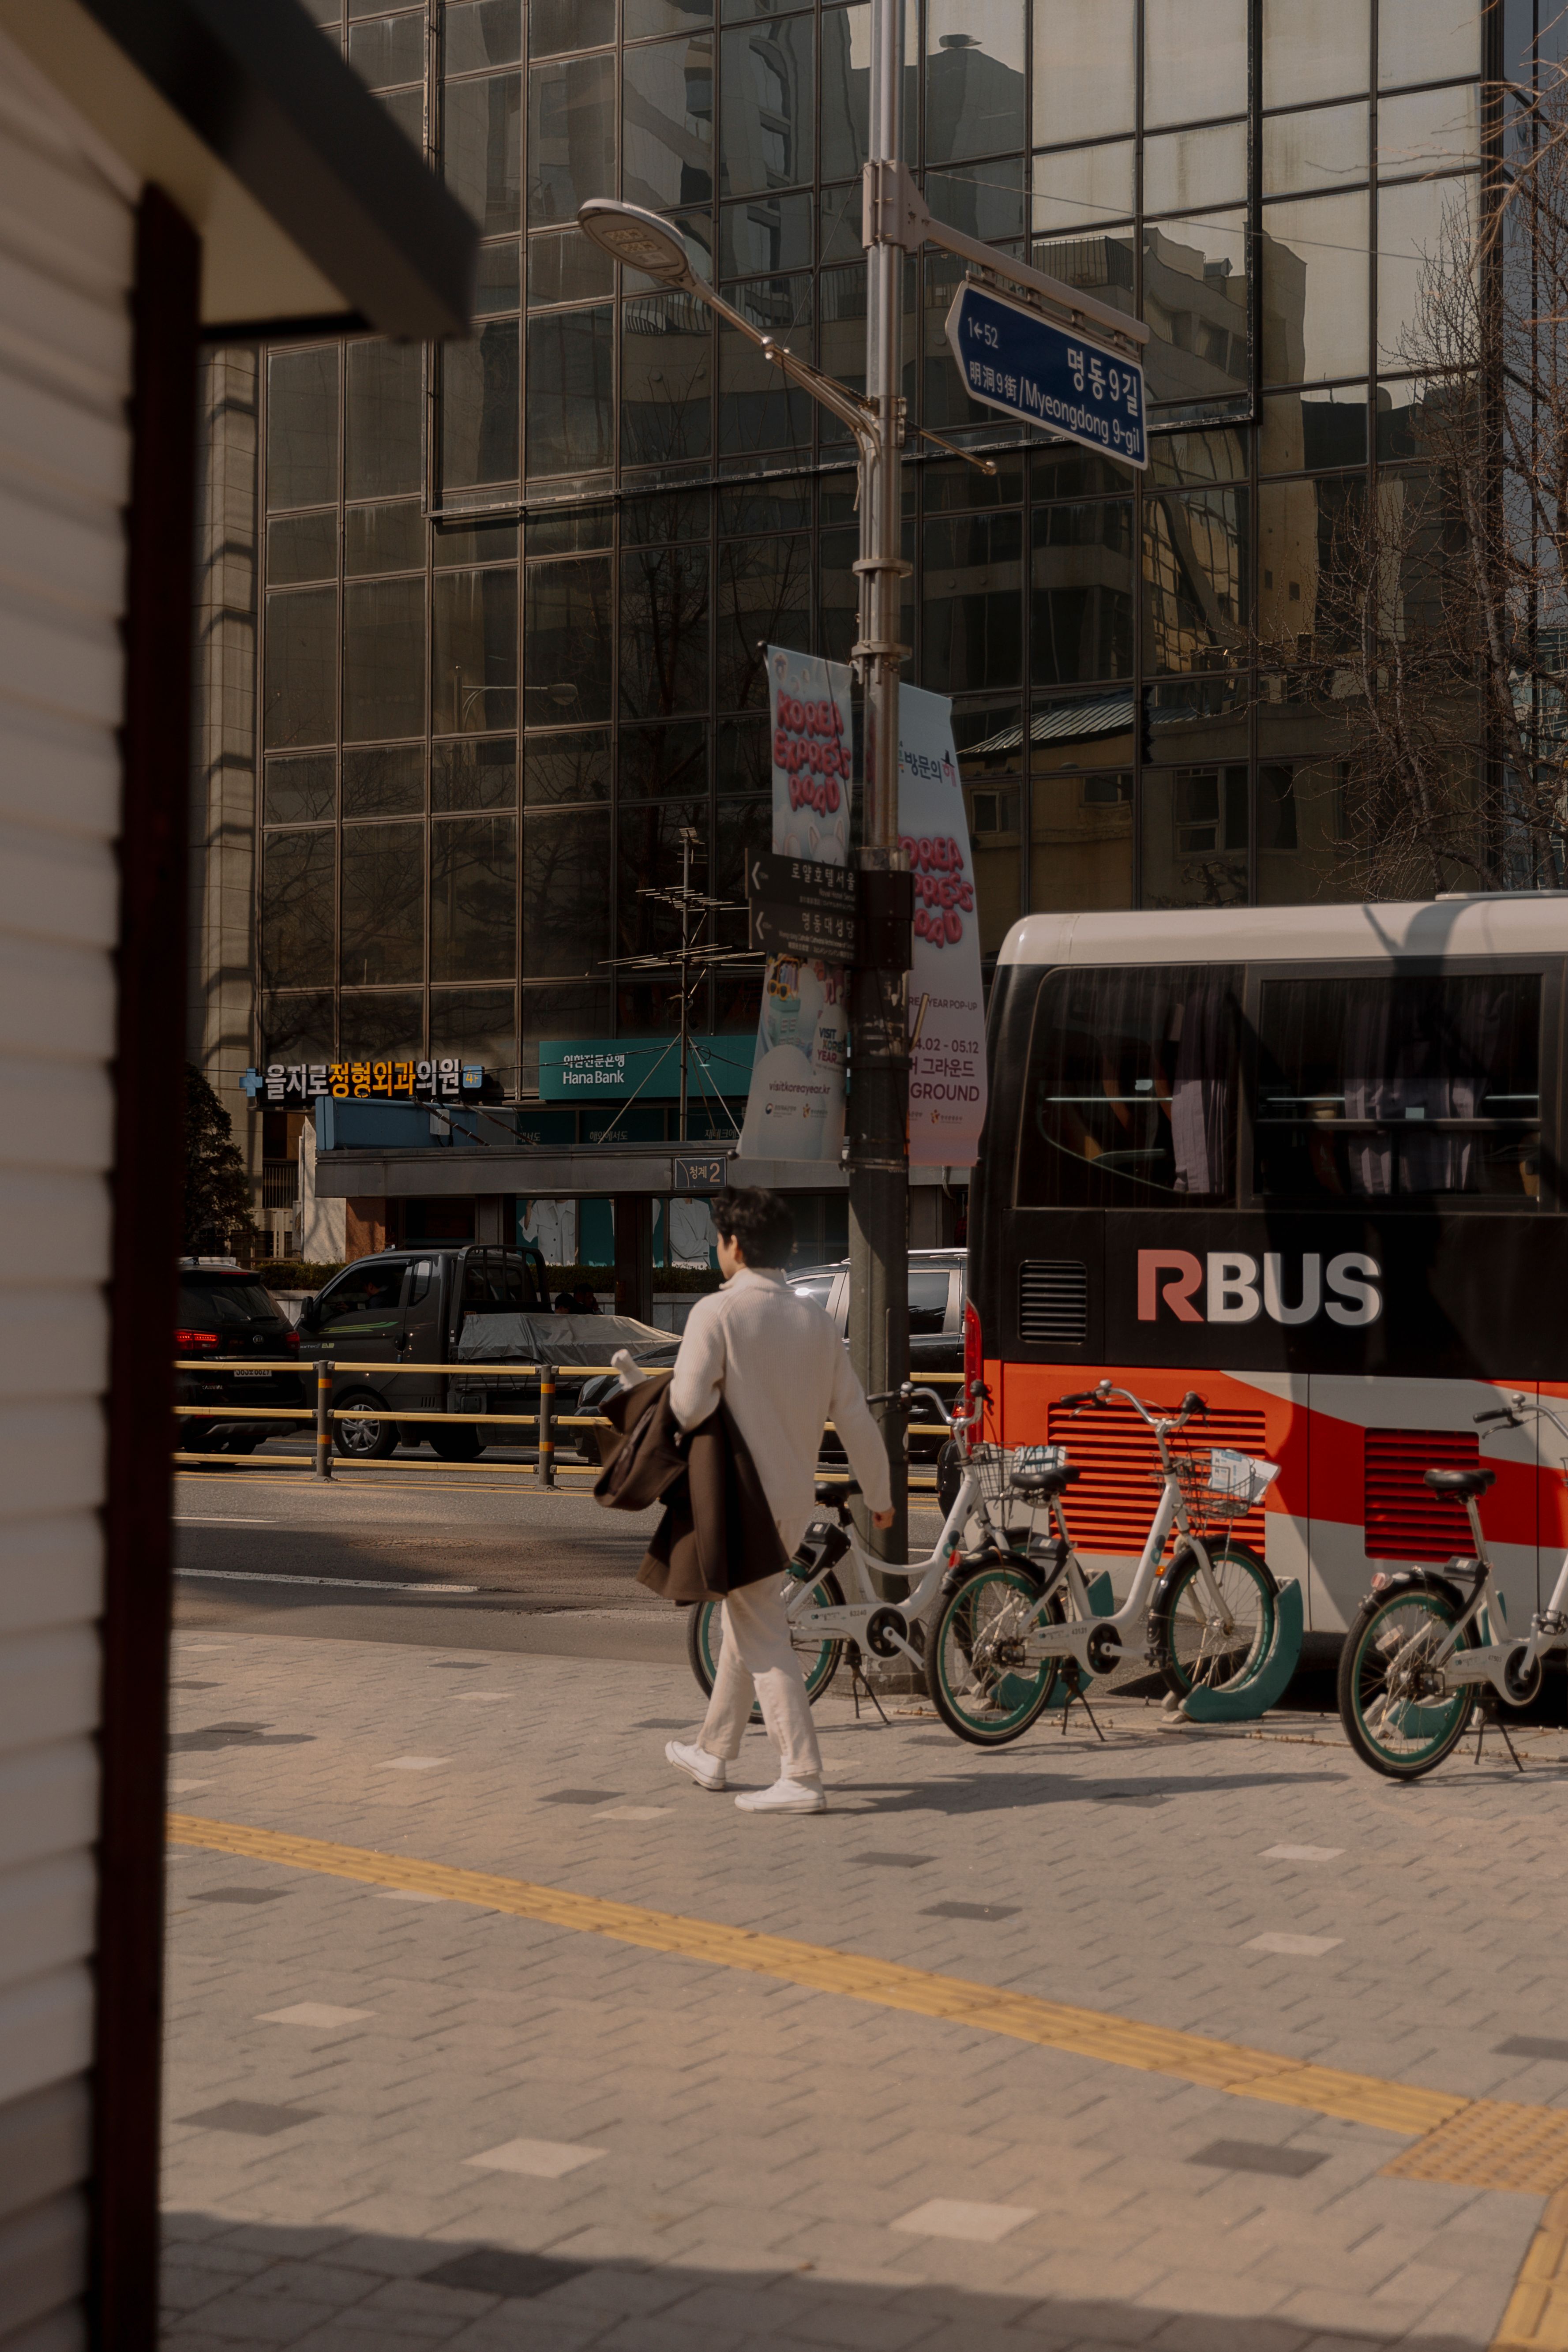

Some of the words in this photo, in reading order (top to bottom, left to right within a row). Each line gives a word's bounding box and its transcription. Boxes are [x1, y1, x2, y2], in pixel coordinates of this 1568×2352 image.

[984, 323, 999, 349] 52
[1067, 347, 1138, 416] 명동9길
[1113, 418, 1140, 455] 9-gil
[777, 689, 844, 738] KOREA
[774, 728, 851, 780] EXPRESS
[788, 773, 840, 818] ROAD
[898, 833, 964, 872] OREA
[791, 863, 856, 891] 로얄호텔서울
[802, 912, 855, 939] 명동대성당
[949, 1000, 978, 1011] POP-UP
[819, 1028, 837, 1038] VISIT
[817, 1050, 837, 1064] YEAR
[951, 1039, 979, 1054] 05.12
[265, 1058, 460, 1100] 을지로정형외과의원
[563, 1071, 593, 1084] Hana
[595, 1069, 625, 1084] Bank
[921, 1058, 975, 1077] 그라운드
[769, 1081, 831, 1096] visitkoreayear.kr
[910, 1082, 980, 1102] GROUND
[704, 1129, 740, 1140] 재테크에
[689, 1165, 707, 1180] 청계
[709, 1162, 720, 1183] 2
[1137, 1249, 1383, 1327] RBUS
